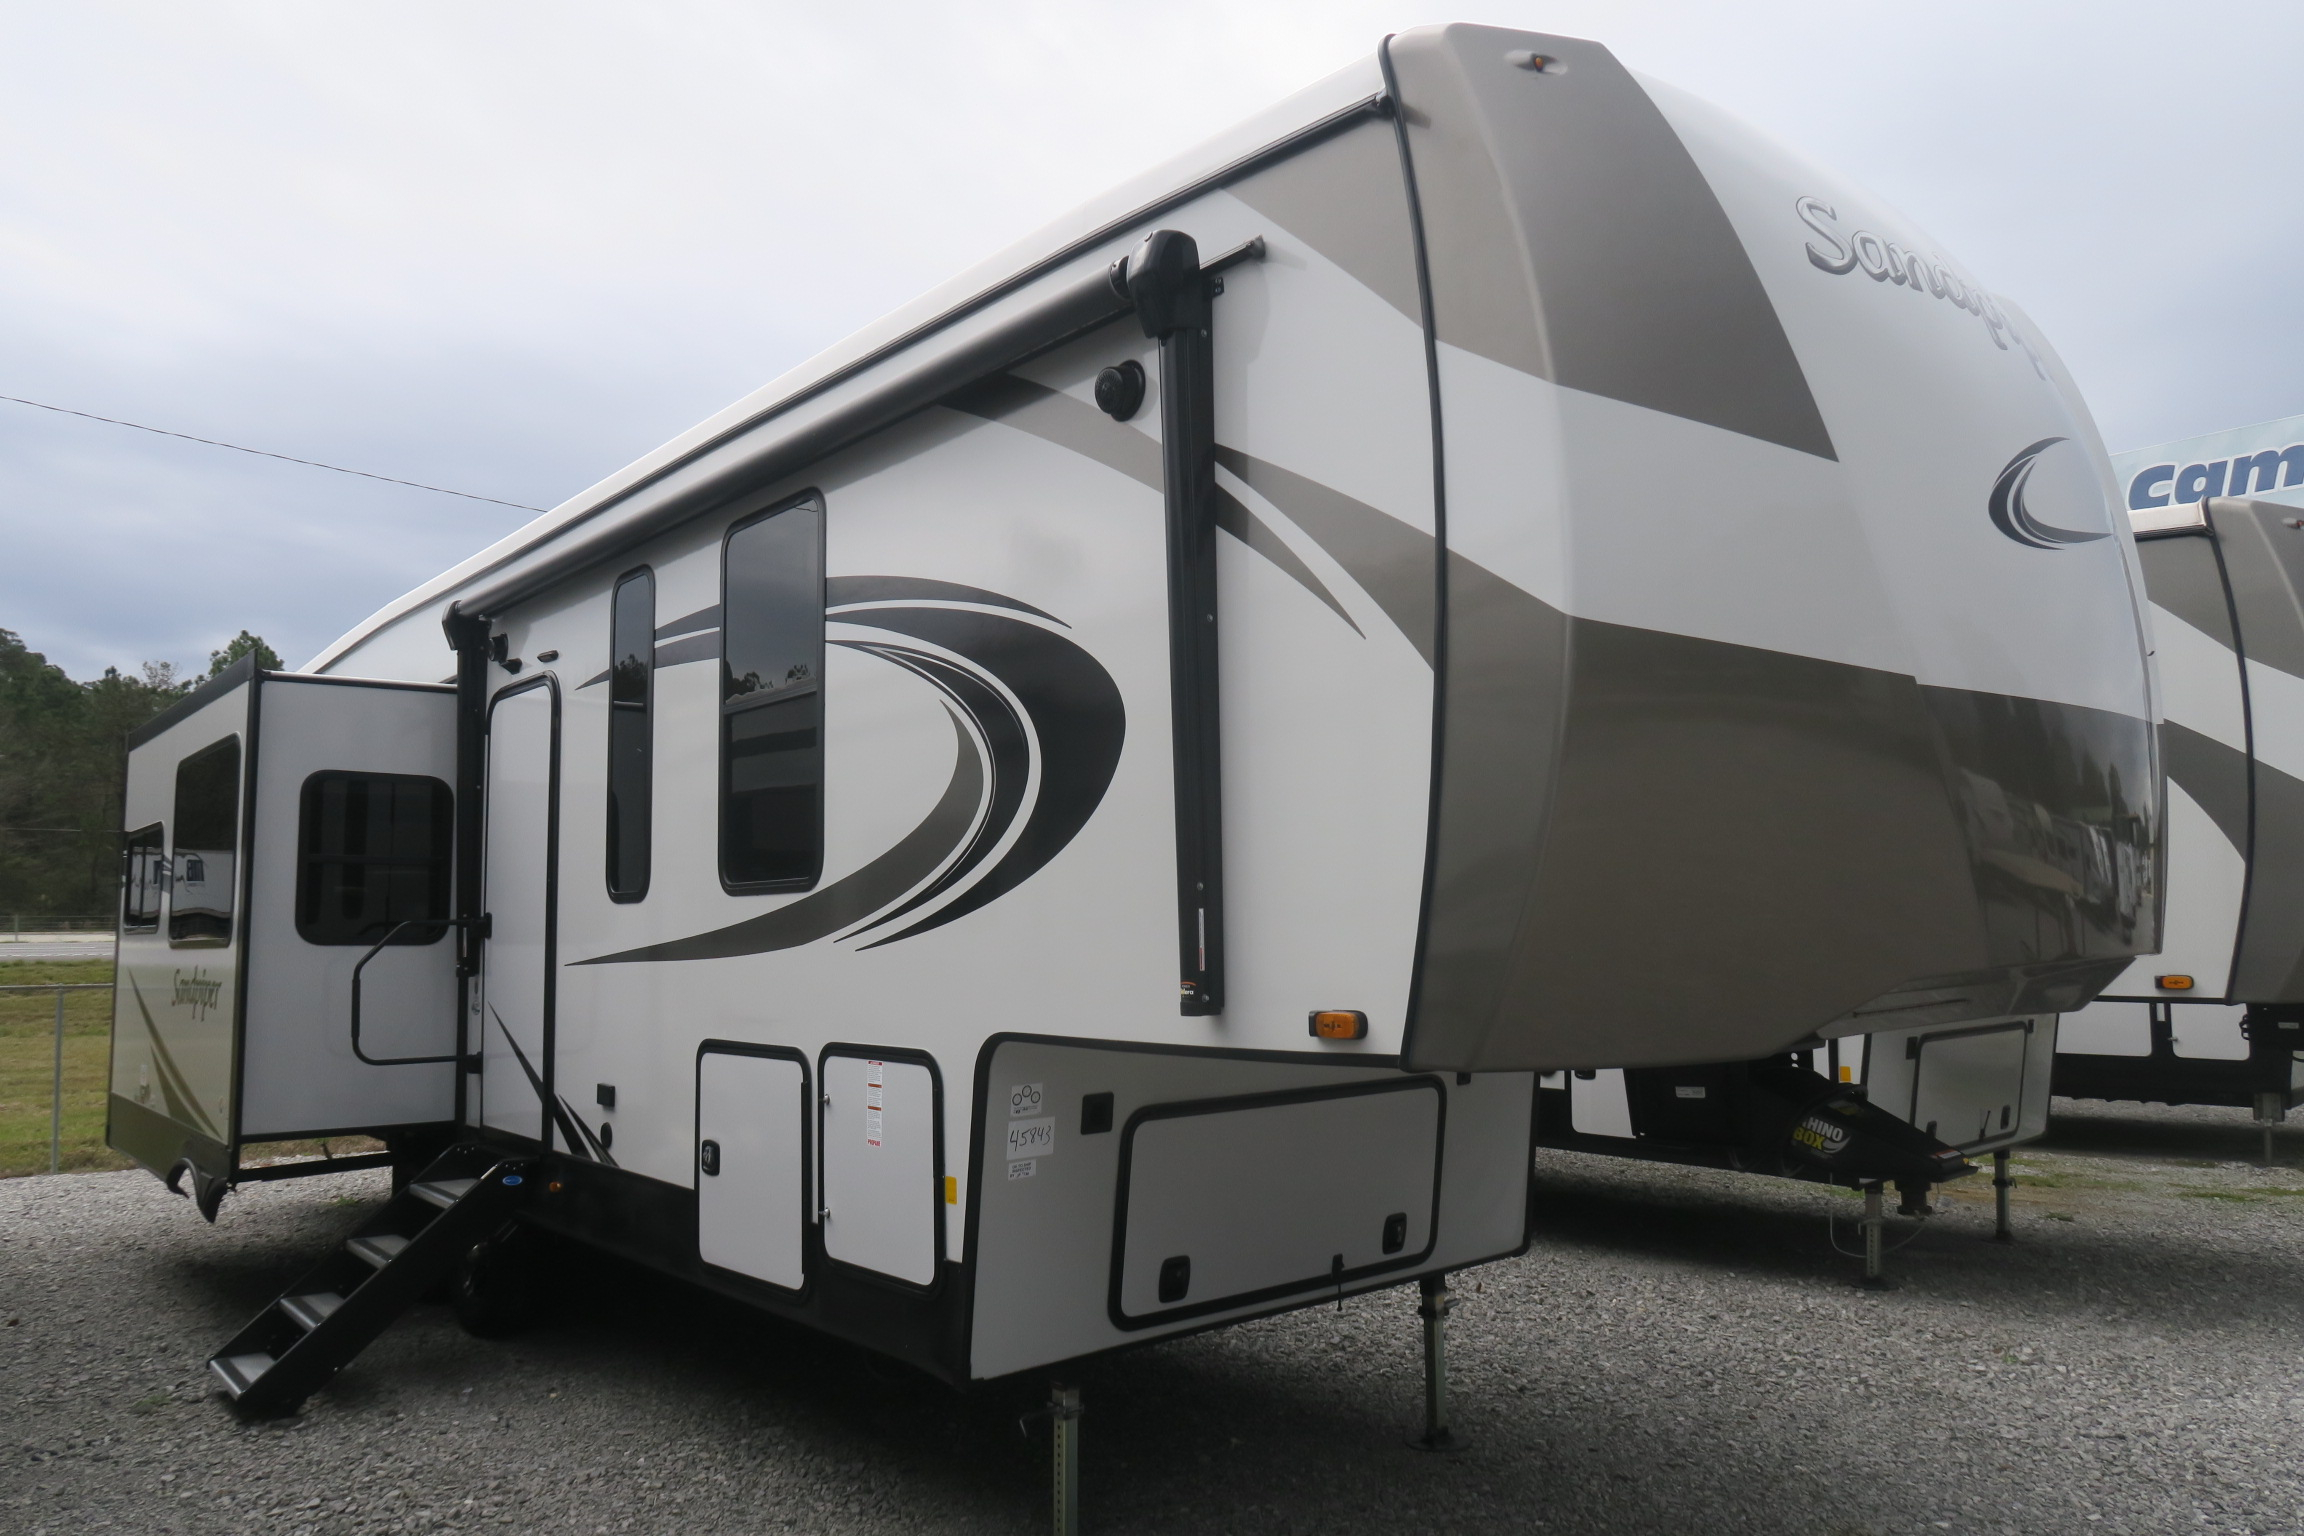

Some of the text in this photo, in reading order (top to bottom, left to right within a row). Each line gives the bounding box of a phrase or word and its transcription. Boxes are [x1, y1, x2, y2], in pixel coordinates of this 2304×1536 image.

[172, 964, 222, 1021] Sandpiper
[1010, 1125, 1051, 1152] 45843
[1793, 1126, 1826, 1150] BOX
